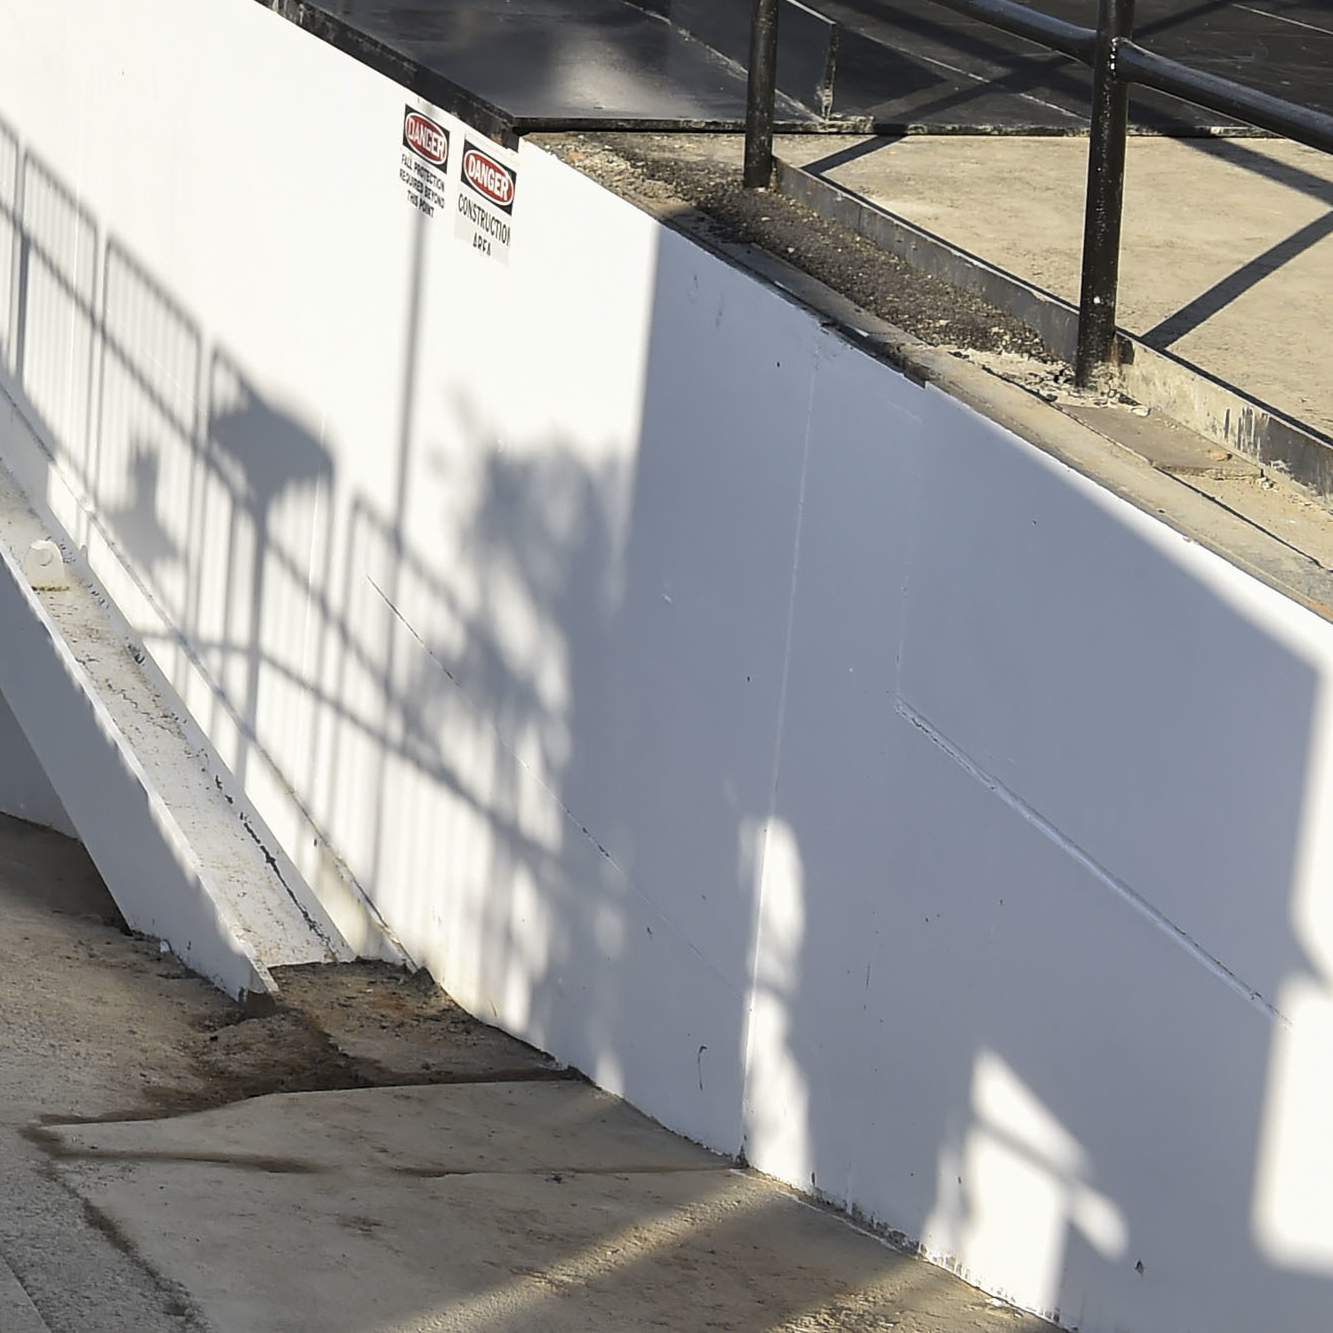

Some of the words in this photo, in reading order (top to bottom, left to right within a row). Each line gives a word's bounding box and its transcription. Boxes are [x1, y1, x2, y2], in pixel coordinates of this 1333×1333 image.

[406, 116, 446, 160] DANGER
[468, 154, 510, 201] DANGER
[472, 232, 492, 256] AREA
